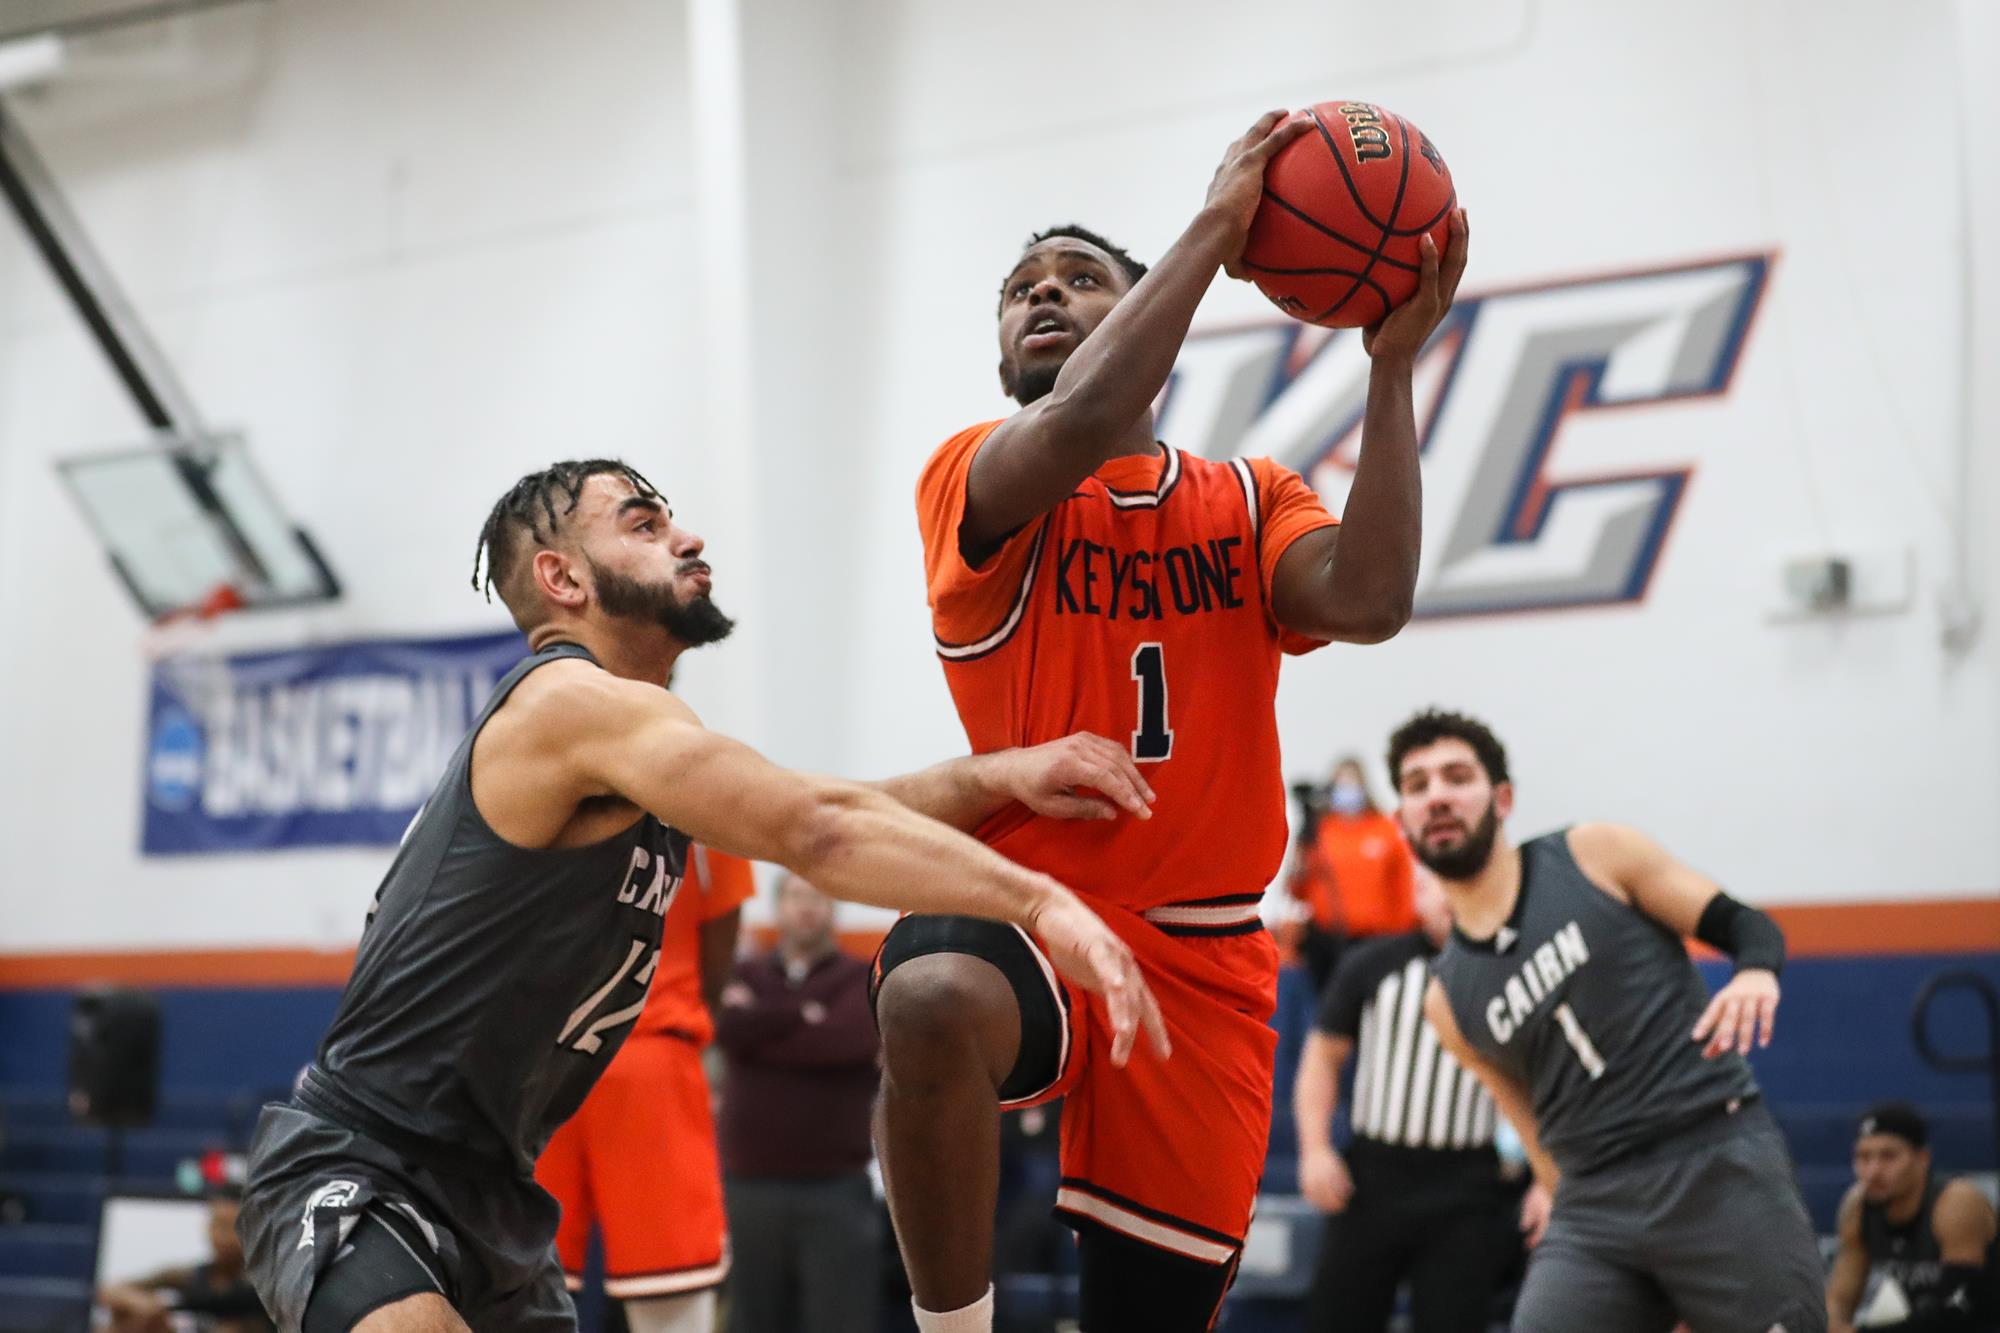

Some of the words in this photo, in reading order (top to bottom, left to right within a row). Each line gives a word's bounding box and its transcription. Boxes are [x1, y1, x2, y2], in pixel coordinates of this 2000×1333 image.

[1338, 103, 1392, 164] Wil
[203, 667, 492, 818] BASKETBA
[1131, 641, 1174, 763] 1
[556, 939, 662, 1055] 12
[1486, 921, 1590, 1044] CAIRN
[1554, 1003, 1607, 1081] 1
